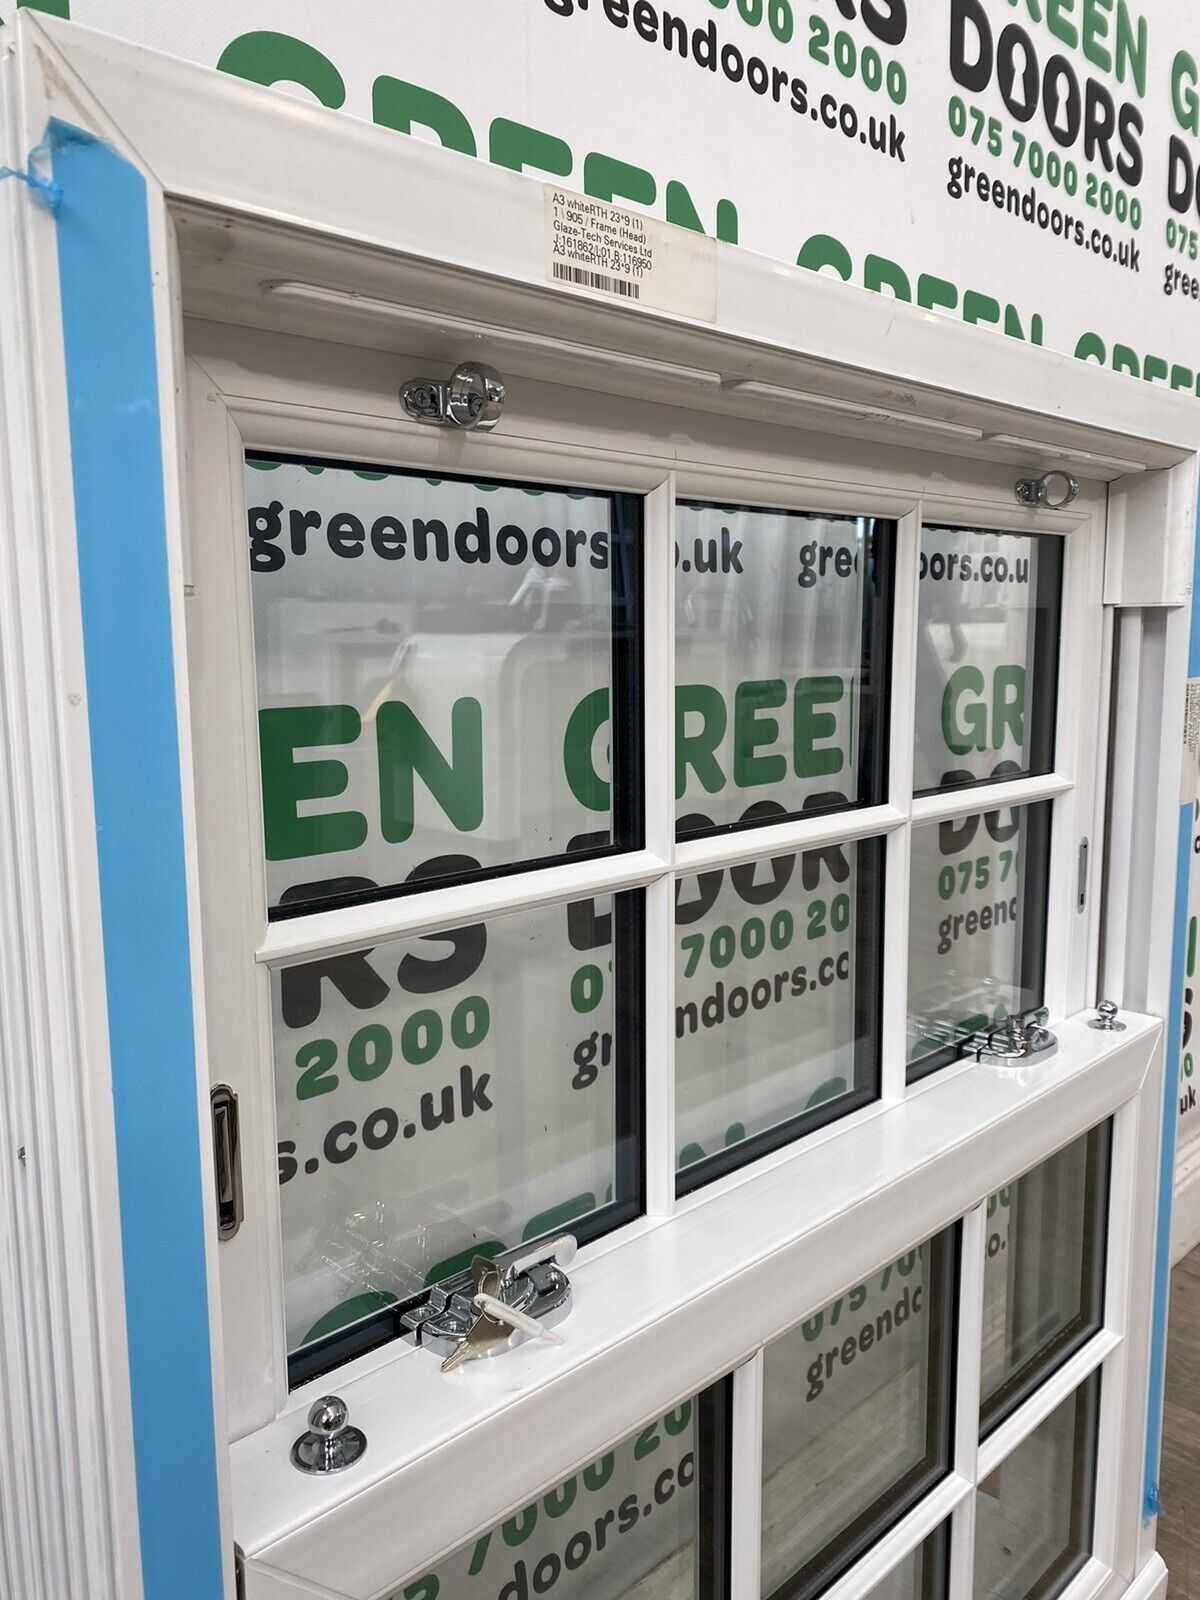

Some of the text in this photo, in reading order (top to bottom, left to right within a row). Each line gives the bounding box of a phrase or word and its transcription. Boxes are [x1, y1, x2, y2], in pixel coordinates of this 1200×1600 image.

[544, 0, 905, 162] eendoors.co.uk
[808, 14, 907, 105] 2000
[950, 0, 1144, 187] DOORS
[949, 95, 1142, 231] 075 7000 2000
[552, 193, 565, 206] A3
[566, 199, 608, 219] whiteRTH
[632, 218, 643, 231] (1)
[553, 220, 652, 258] Glaze-Tech Services Ltd
[553, 244, 565, 256] A3
[567, 211, 583, 225] 905
[590, 218, 617, 235] Frame
[619, 227, 646, 245] (Head)
[947, 156, 1140, 272] greendoors.co.uk
[1166, 218, 1198, 260] 075
[938, 856, 990, 900] 075
[681, 909, 793, 979] 7000
[807, 893, 850, 940] 20
[295, 995, 490, 1101] 2000
